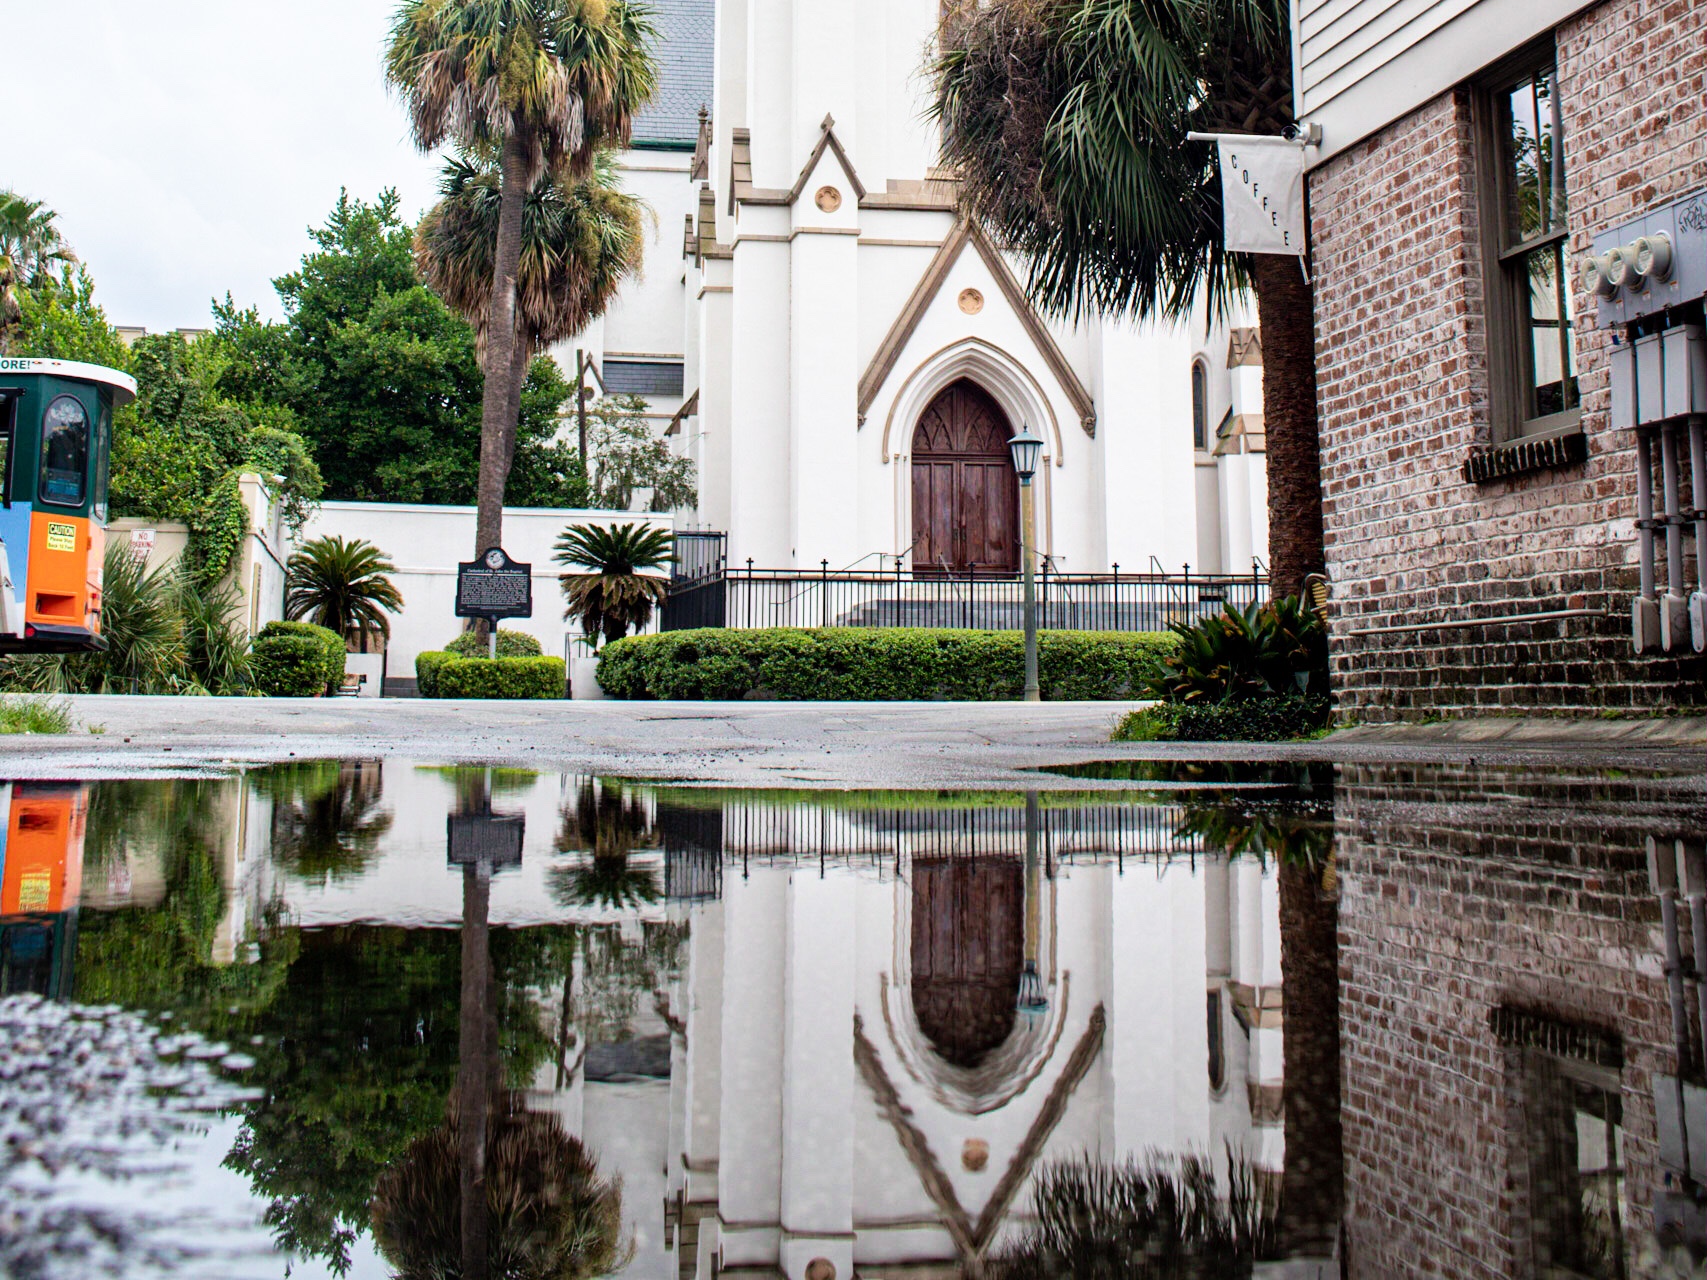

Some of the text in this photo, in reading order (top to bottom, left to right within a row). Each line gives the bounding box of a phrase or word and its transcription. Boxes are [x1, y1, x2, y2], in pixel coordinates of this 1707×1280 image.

[1231, 154, 1289, 246] COFFEE
[50, 524, 75, 536] CAUTION
[138, 532, 148, 540] NO
